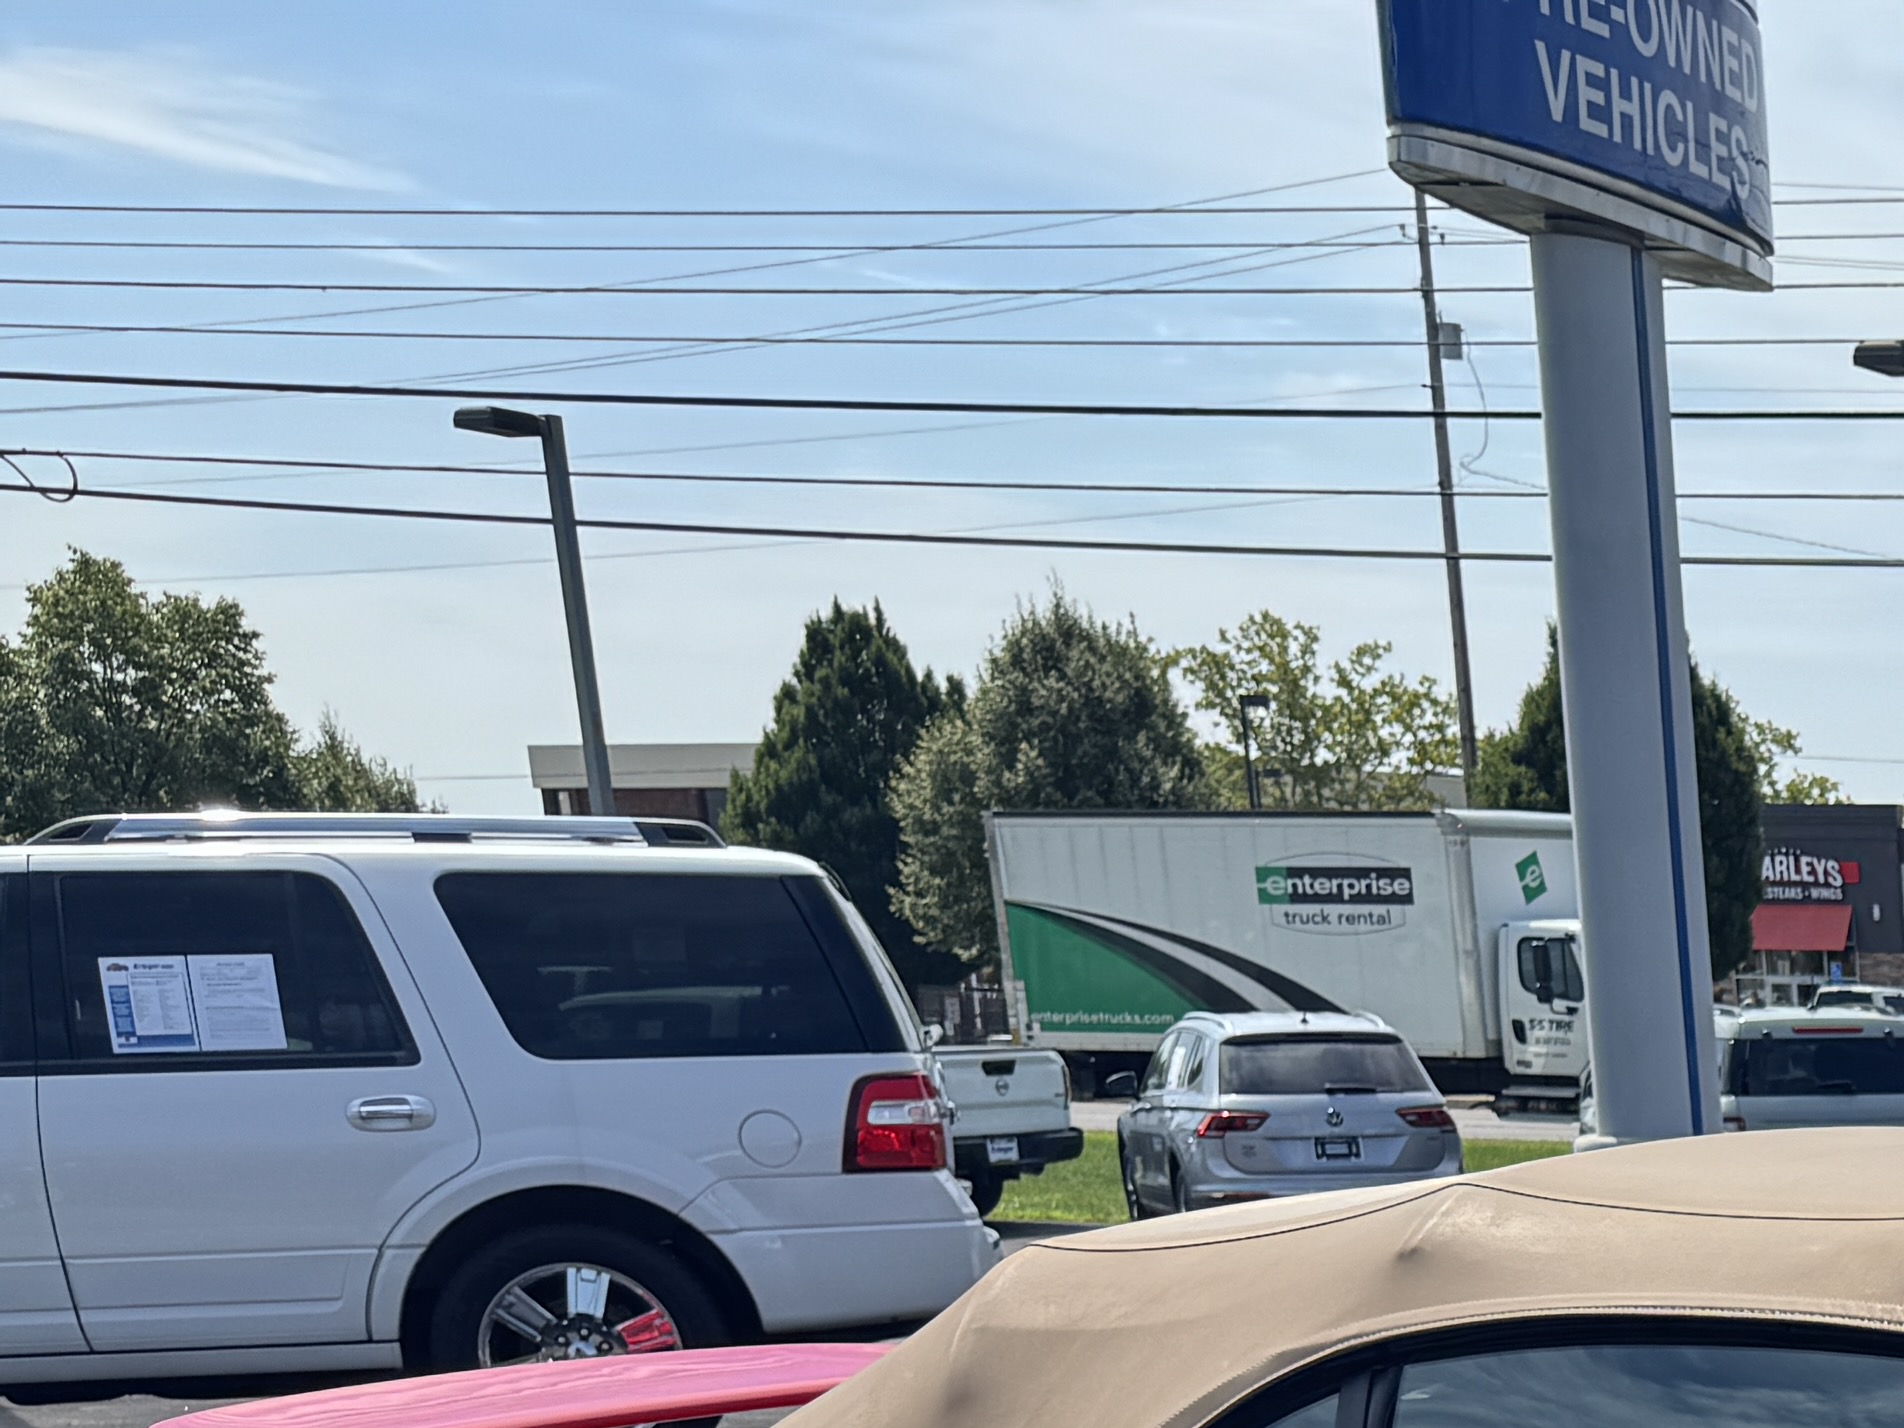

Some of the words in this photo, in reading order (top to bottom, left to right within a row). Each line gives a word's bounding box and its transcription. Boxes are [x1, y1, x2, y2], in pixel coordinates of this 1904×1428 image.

[1534, 39, 1750, 199] VEHICLES
[1258, 872, 1411, 901] enterprise
[1810, 887, 1843, 900] WINGS
[1284, 908, 1331, 925] truck
[1337, 909, 1392, 926] rental
[1031, 1010, 1175, 1026] enterprisetrucks.com
